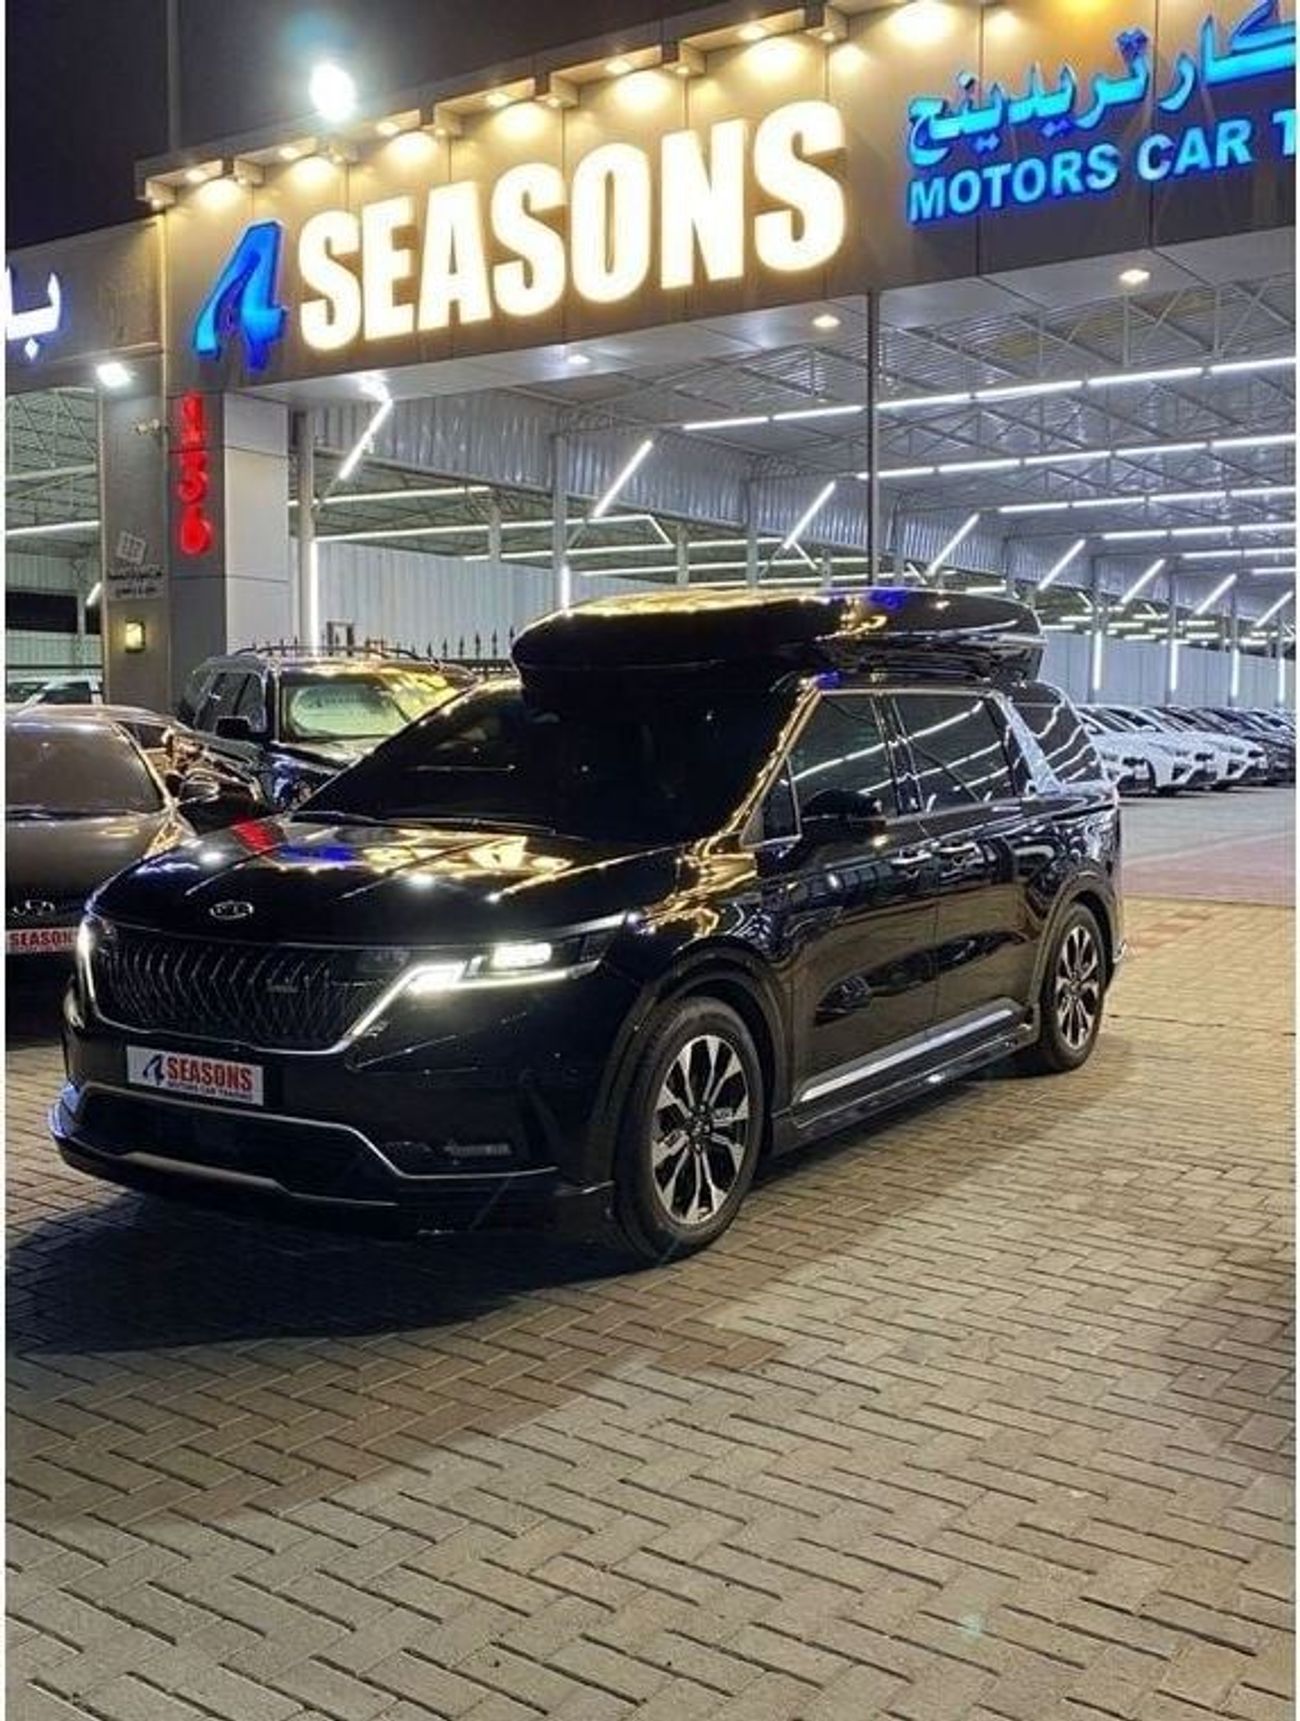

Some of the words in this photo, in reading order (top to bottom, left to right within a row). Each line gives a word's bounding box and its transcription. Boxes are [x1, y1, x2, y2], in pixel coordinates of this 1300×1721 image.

[908, 145, 1120, 224] MOTORS
[1136, 119, 1253, 182] CAR
[298, 100, 848, 351] SEASONS
[9, 930, 80, 946] SEASON
[166, 1056, 254, 1092] SEASONS
